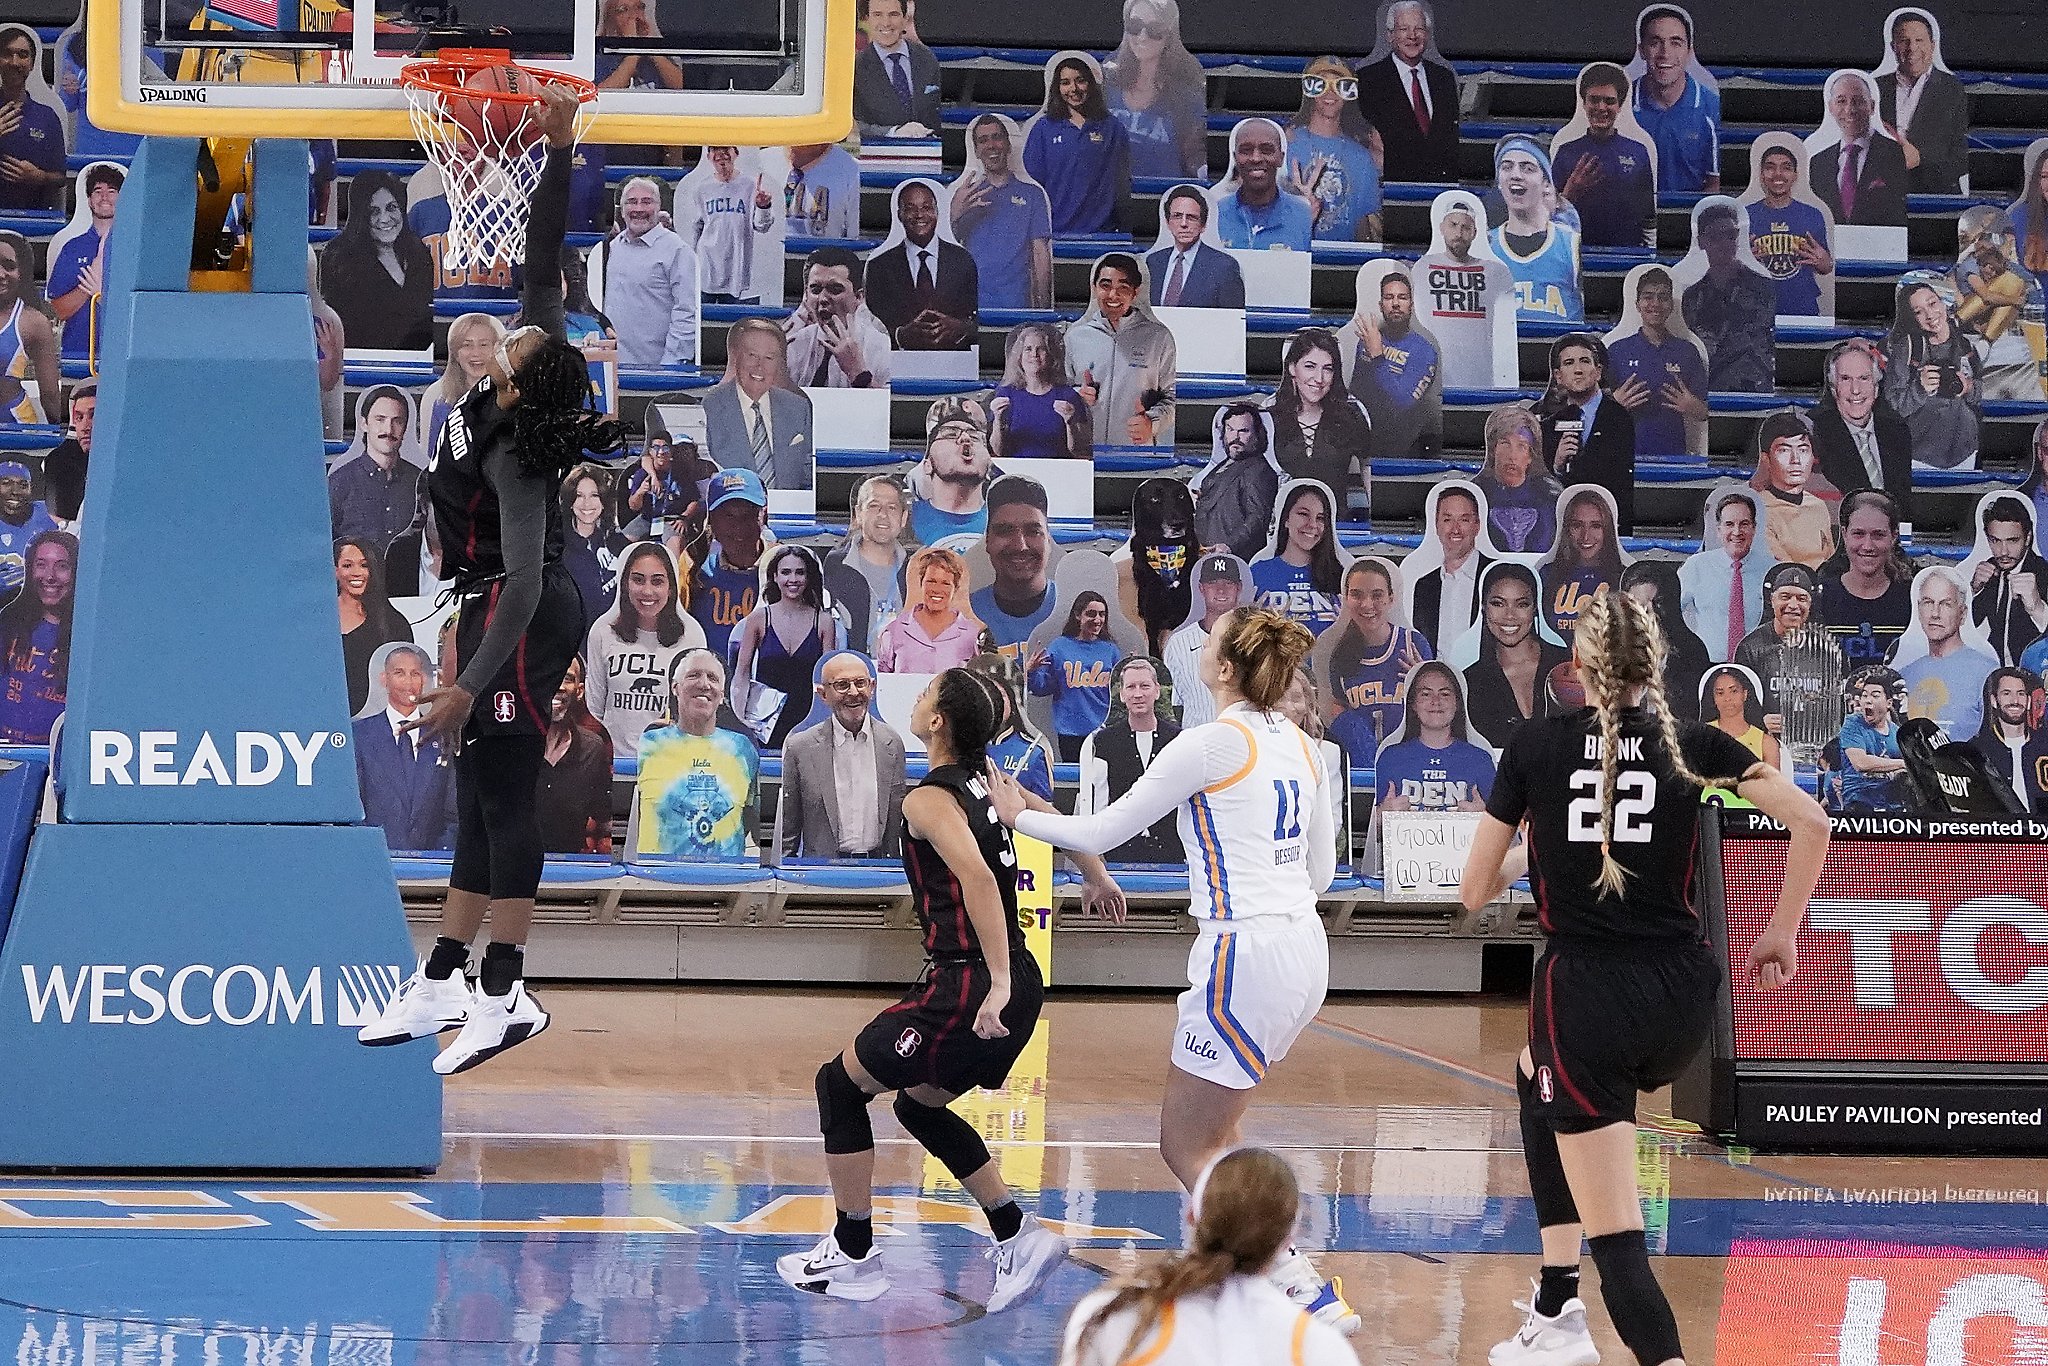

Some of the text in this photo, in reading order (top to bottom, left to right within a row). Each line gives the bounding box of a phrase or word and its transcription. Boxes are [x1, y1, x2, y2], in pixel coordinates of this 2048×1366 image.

[139, 87, 207, 103] SPALDING
[705, 197, 746, 215] UCLA
[1428, 270, 1487, 291] CLUB
[1430, 290, 1487, 312] TRIL
[710, 587, 754, 626] Ucl
[1269, 591, 1333, 612] DEN
[608, 653, 665, 678] UCL
[1063, 660, 1111, 689] Ucla
[613, 692, 667, 713] BRUIN
[1345, 680, 1405, 709] UCLA
[1584, 734, 1645, 762] BNK
[692, 758, 711, 768] Ucla
[1422, 770, 1446, 780] THE
[1401, 778, 1468, 807] DEN
[1273, 779, 1302, 841] 11
[1568, 769, 1657, 843] 22
[1748, 813, 2048, 840] PAU PAVILION presented by
[21, 964, 323, 1026] WESCOM
[1185, 1031, 1218, 1061] Ucla
[1766, 1104, 2042, 1129] PAULEY PAVILION presented
